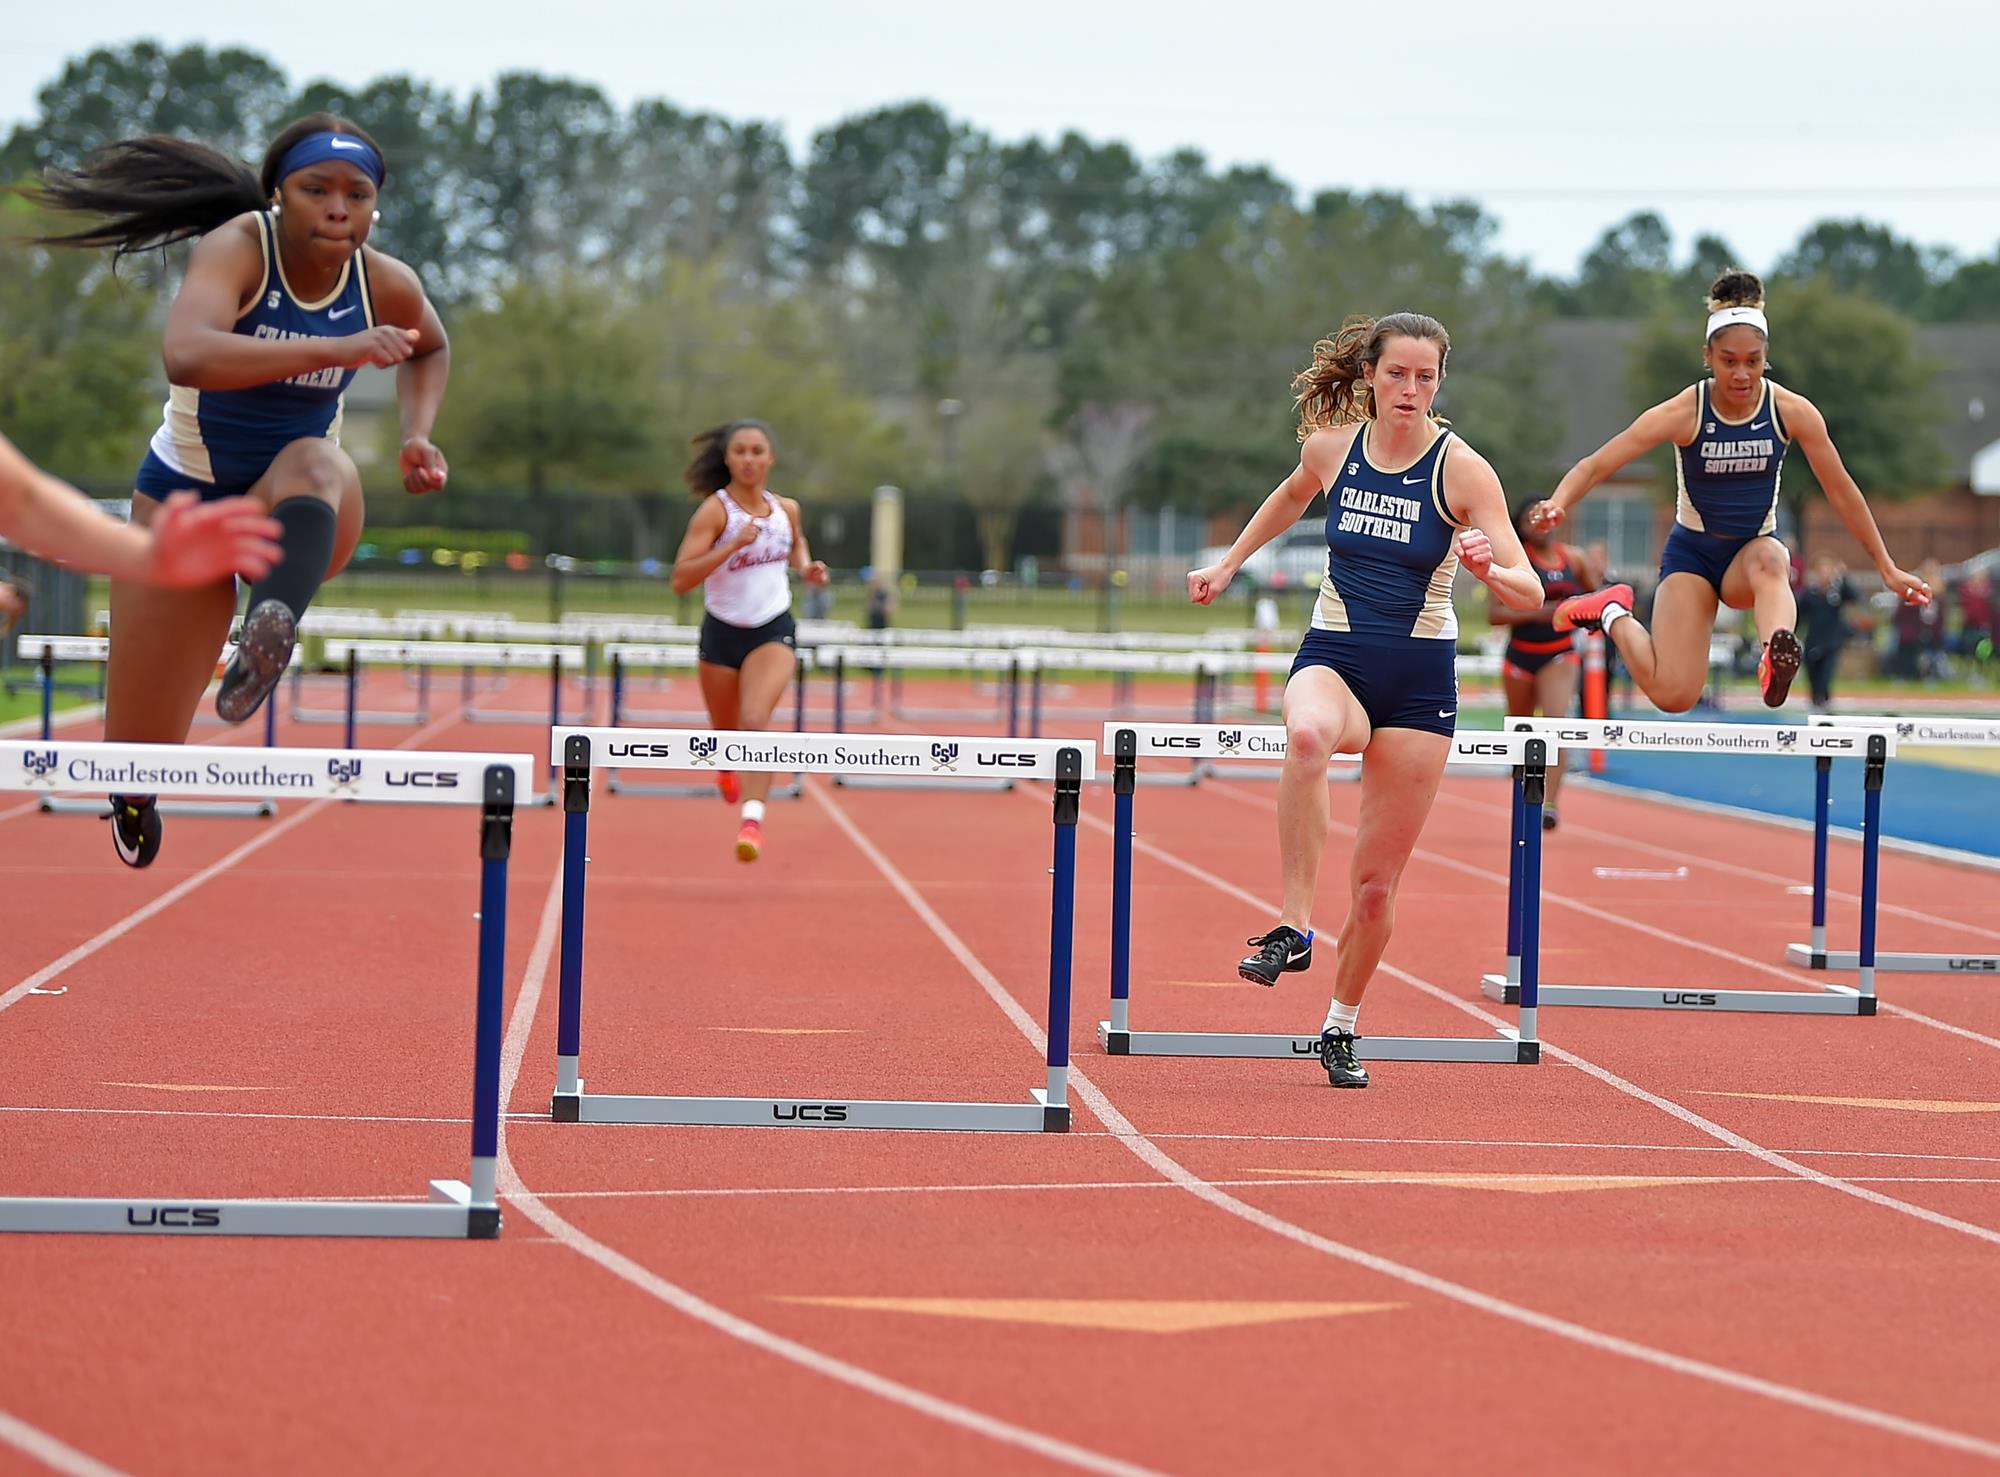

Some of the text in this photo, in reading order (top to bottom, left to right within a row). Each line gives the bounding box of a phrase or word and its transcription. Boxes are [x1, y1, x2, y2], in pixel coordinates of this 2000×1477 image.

[1701, 439, 1774, 458] CHARLESTON
[1705, 458, 1768, 473] SOUTHERN
[1340, 487, 1421, 522] CHARLESTON
[1338, 511, 1411, 544] SOUTHERN
[1151, 736, 1201, 748] UCS
[1218, 730, 1242, 748] CSU
[1458, 743, 1508, 755] UCS
[1546, 730, 1588, 740] CS
[1628, 731, 1704, 746] Charleston
[1706, 733, 1770, 748] Southern
[1810, 738, 1853, 748] UCS
[609, 736, 1037, 767] UCS CSU Charleston Southern CSU UCS
[23, 750, 459, 788] CSU Charleston Southern CSU UCS
[1948, 959, 1997, 970] UCS
[1663, 993, 1716, 1006] UCS
[773, 1104, 847, 1121] UCS
[127, 1207, 220, 1227] UCS
